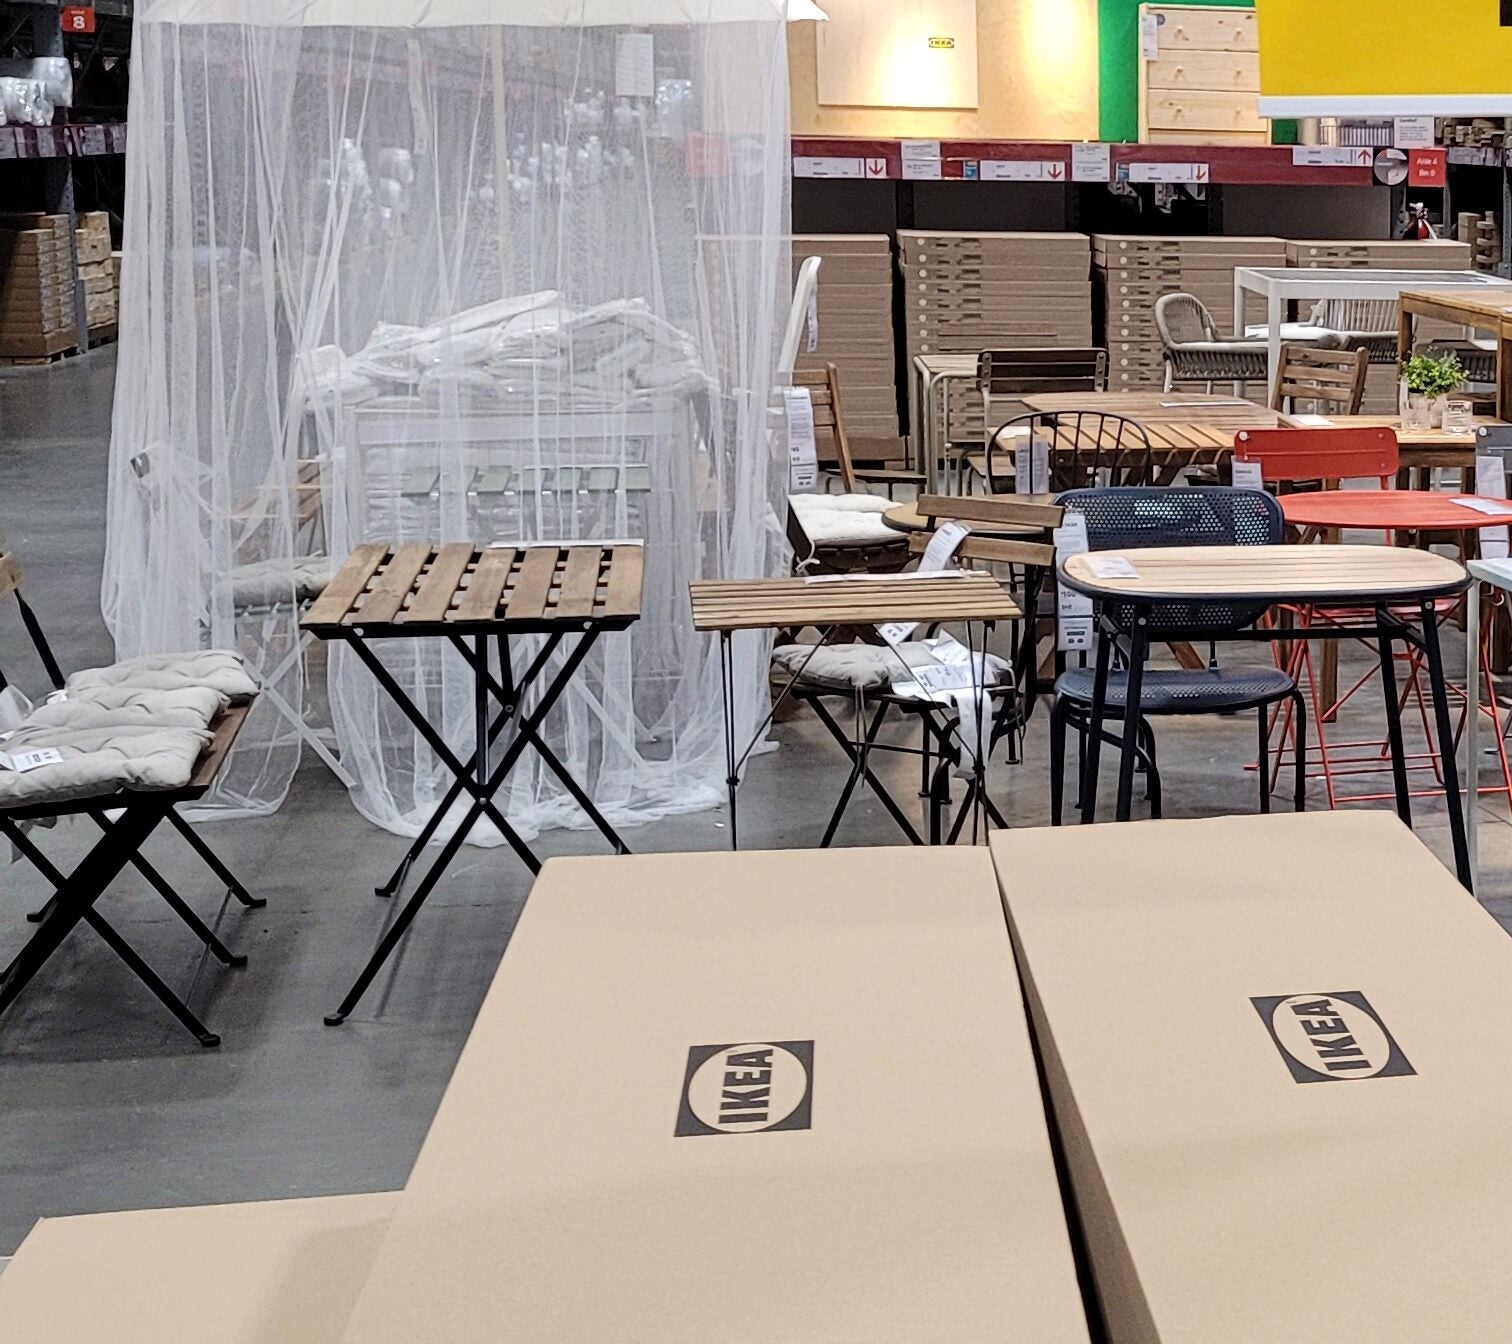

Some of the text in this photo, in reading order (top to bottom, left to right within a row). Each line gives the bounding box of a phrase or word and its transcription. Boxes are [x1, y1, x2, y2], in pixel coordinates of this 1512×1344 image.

[73, 16, 85, 29] 8
[1290, 999, 1372, 1071] IKEA
[718, 1049, 774, 1124] IKEA
